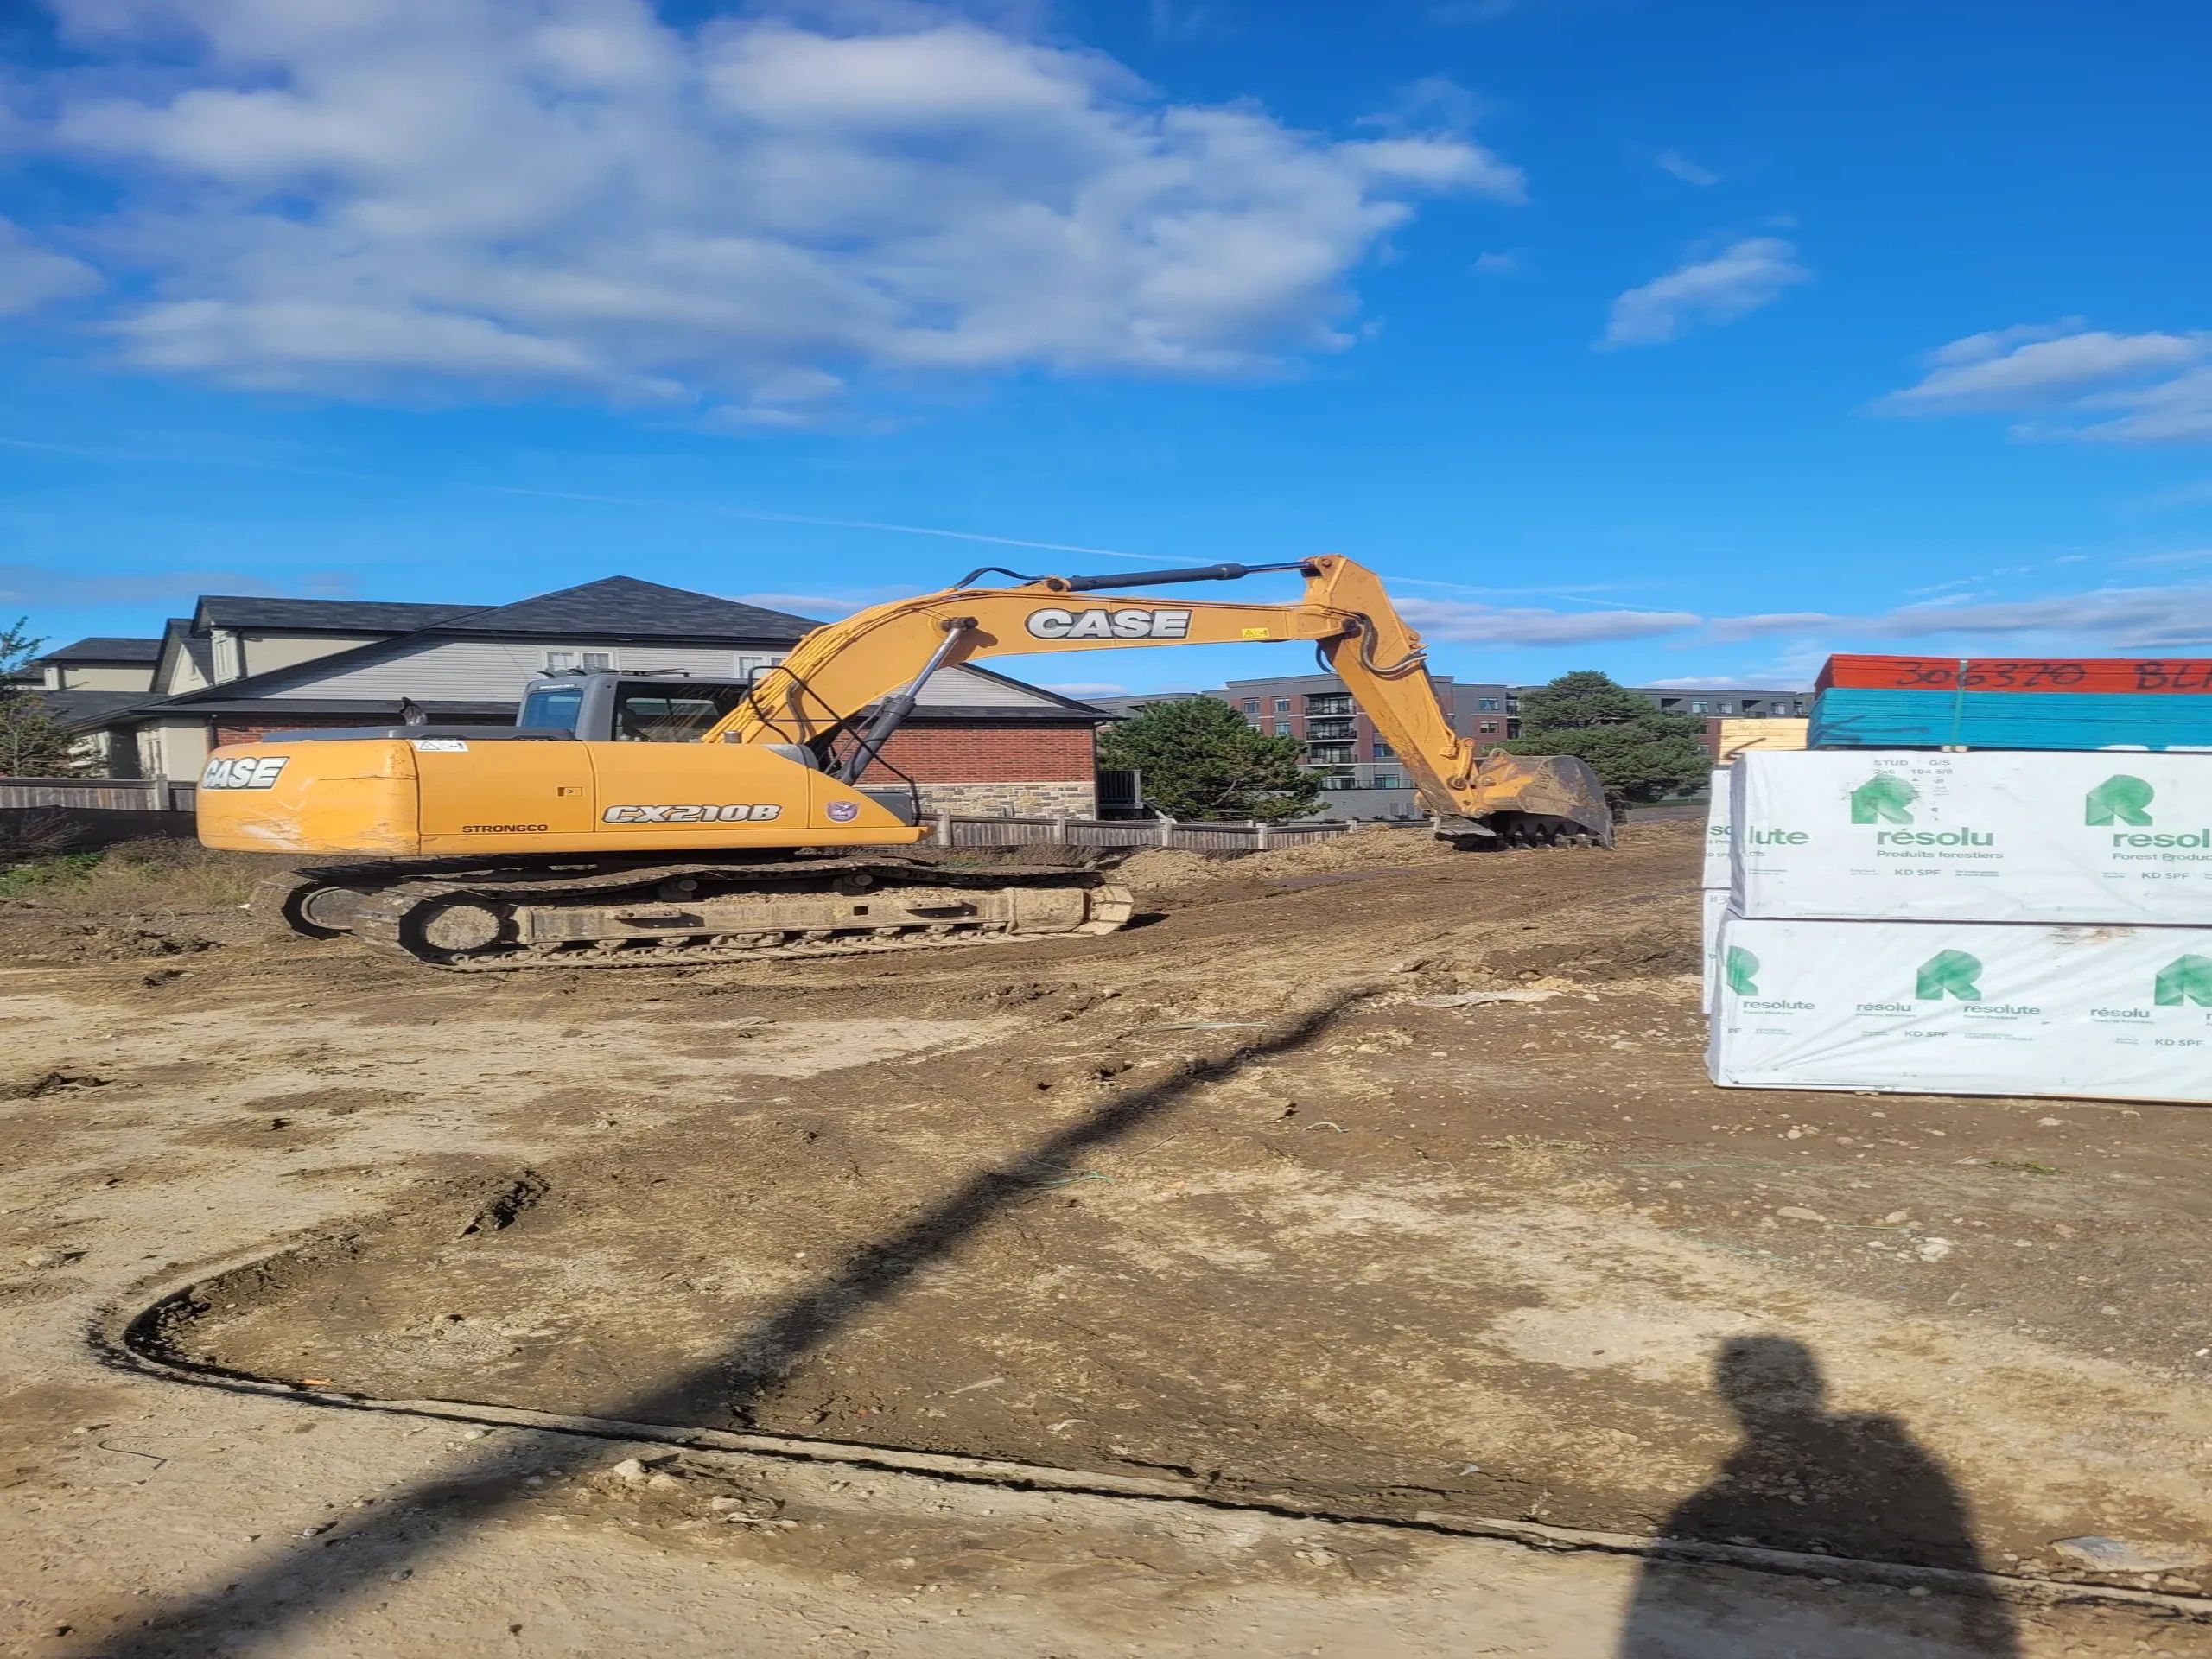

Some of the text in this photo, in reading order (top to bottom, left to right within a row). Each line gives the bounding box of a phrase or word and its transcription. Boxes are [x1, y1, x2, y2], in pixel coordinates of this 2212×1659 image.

[1027, 608, 1193, 639] CASE
[202, 755, 290, 789] CASE
[602, 804, 782, 823] CX210B
[462, 824, 548, 833] STRONGCO
[1877, 827, 1994, 847] résolu
[2113, 828, 2210, 849] resol
[1877, 850, 2004, 860] Produits forestiers
[2113, 852, 2158, 861] Forest
[1743, 1000, 1815, 1010] resolute
[1856, 1001, 1912, 1012] résolu
[1964, 1004, 2041, 1014] resolute
[2090, 1007, 2151, 1019] résolu
